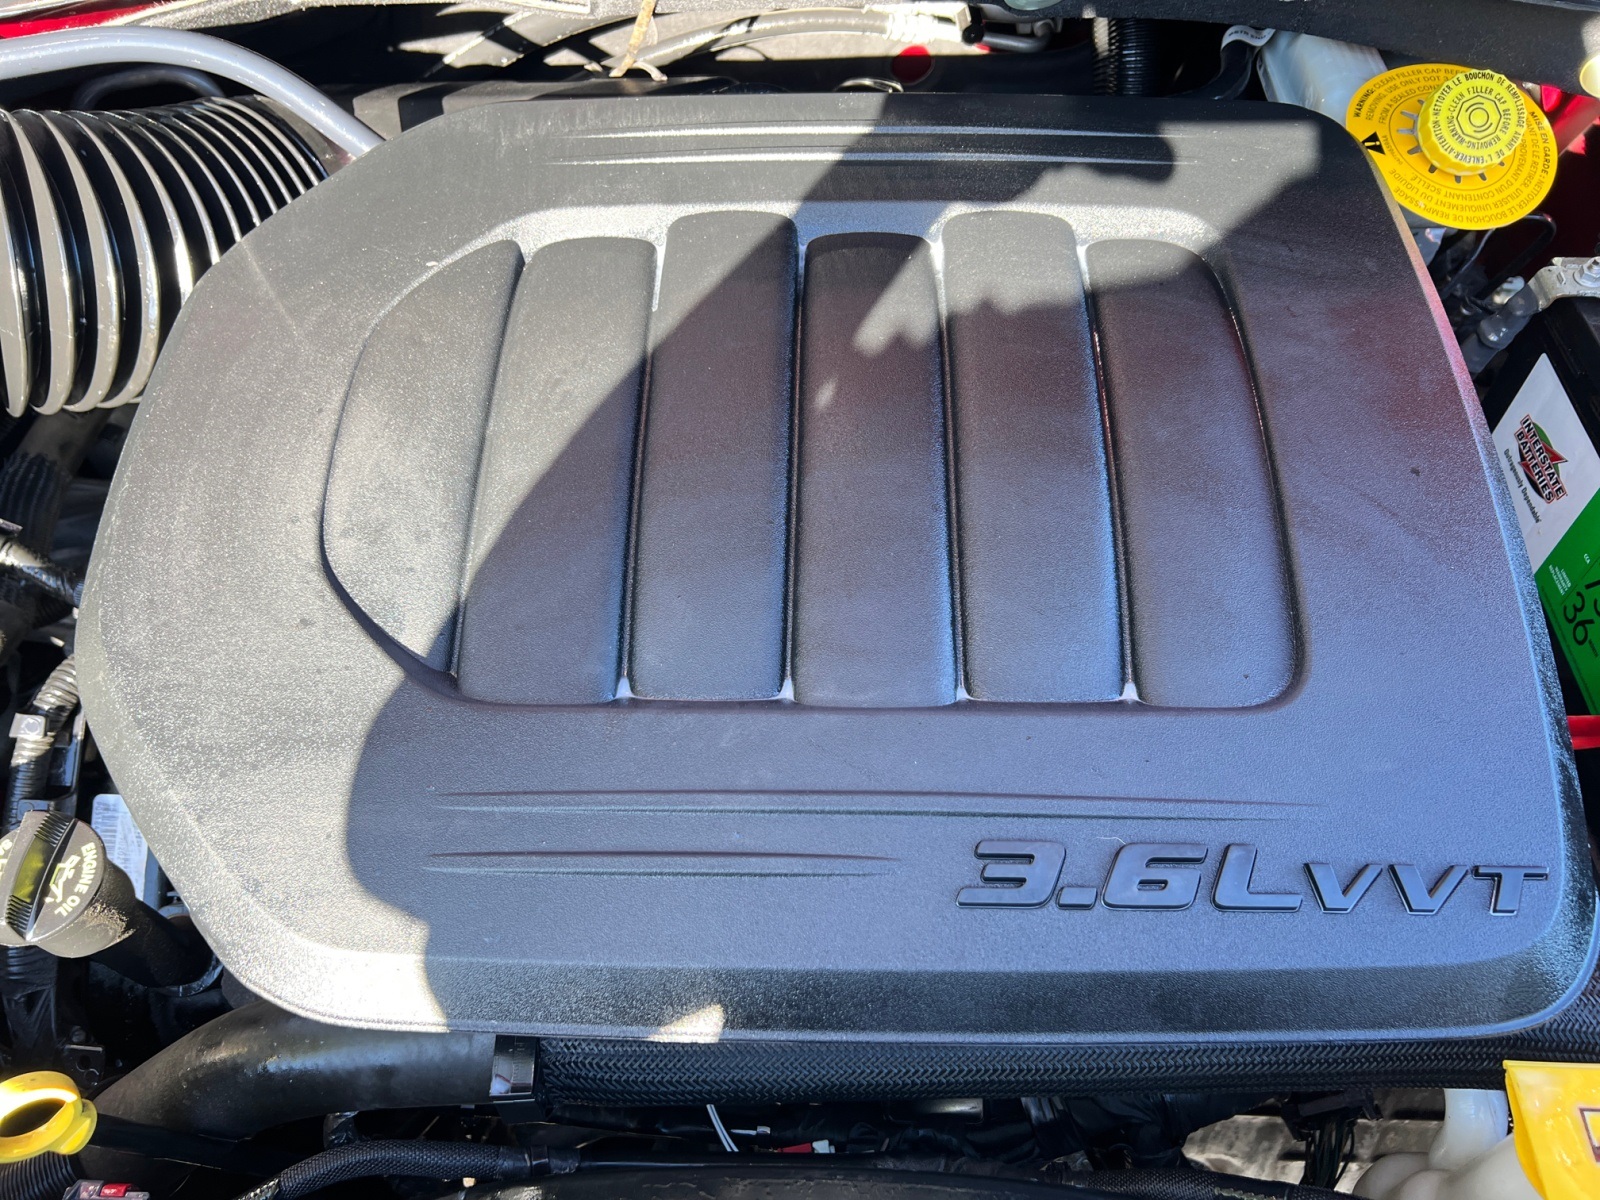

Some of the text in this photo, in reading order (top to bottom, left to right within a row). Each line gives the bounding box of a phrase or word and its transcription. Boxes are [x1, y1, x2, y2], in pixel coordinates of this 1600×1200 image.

[1385, 84, 1400, 94] USE
[1399, 77, 1421, 88] ONLY
[1423, 75, 1441, 83] DOT
[1452, 77, 1462, 87] LE
[1464, 72, 1495, 82] BOUCHON
[1496, 77, 1506, 87] DE
[1353, 87, 1375, 118] WARNING:
[1373, 76, 1396, 90] CLEAN
[1396, 69, 1422, 80] FILLER
[1390, 88, 1417, 104] SEALED
[1433, 85, 1453, 116] NETTOYER
[1466, 86, 1494, 96] FILLER
[1494, 92, 1507, 105] CAP
[1506, 83, 1526, 128] REMPLISSAGE
[1500, 108, 1512, 135] BEFORE
[1530, 111, 1545, 131] MISE
[1467, 135, 1502, 150] REMOVING
[1506, 131, 1522, 151] AVANT
[1540, 132, 1549, 146] EN
[1496, 148, 1505, 158] DE
[1389, 168, 1420, 195] LIQUIDE
[1393, 186, 1450, 220] REMPLISSAGE
[1419, 190, 1434, 202] DU
[1444, 190, 1495, 202] CONTENANT
[1494, 188, 1524, 207] UTILISER
[1518, 178, 1546, 209] NETTOYER
[1434, 199, 1492, 213] UNIQUEMENT
[1509, 207, 1517, 215] LE
[1452, 214, 1464, 223] DE
[1466, 211, 1508, 224] BOUCHON
[1515, 429, 1555, 502] BATTERIES
[1522, 417, 1566, 498] INTERSTATE
[1563, 591, 1596, 646] 36
[54, 842, 97, 917] ENGINE OIL
[955, 840, 1551, 916] 3.6L VVT
